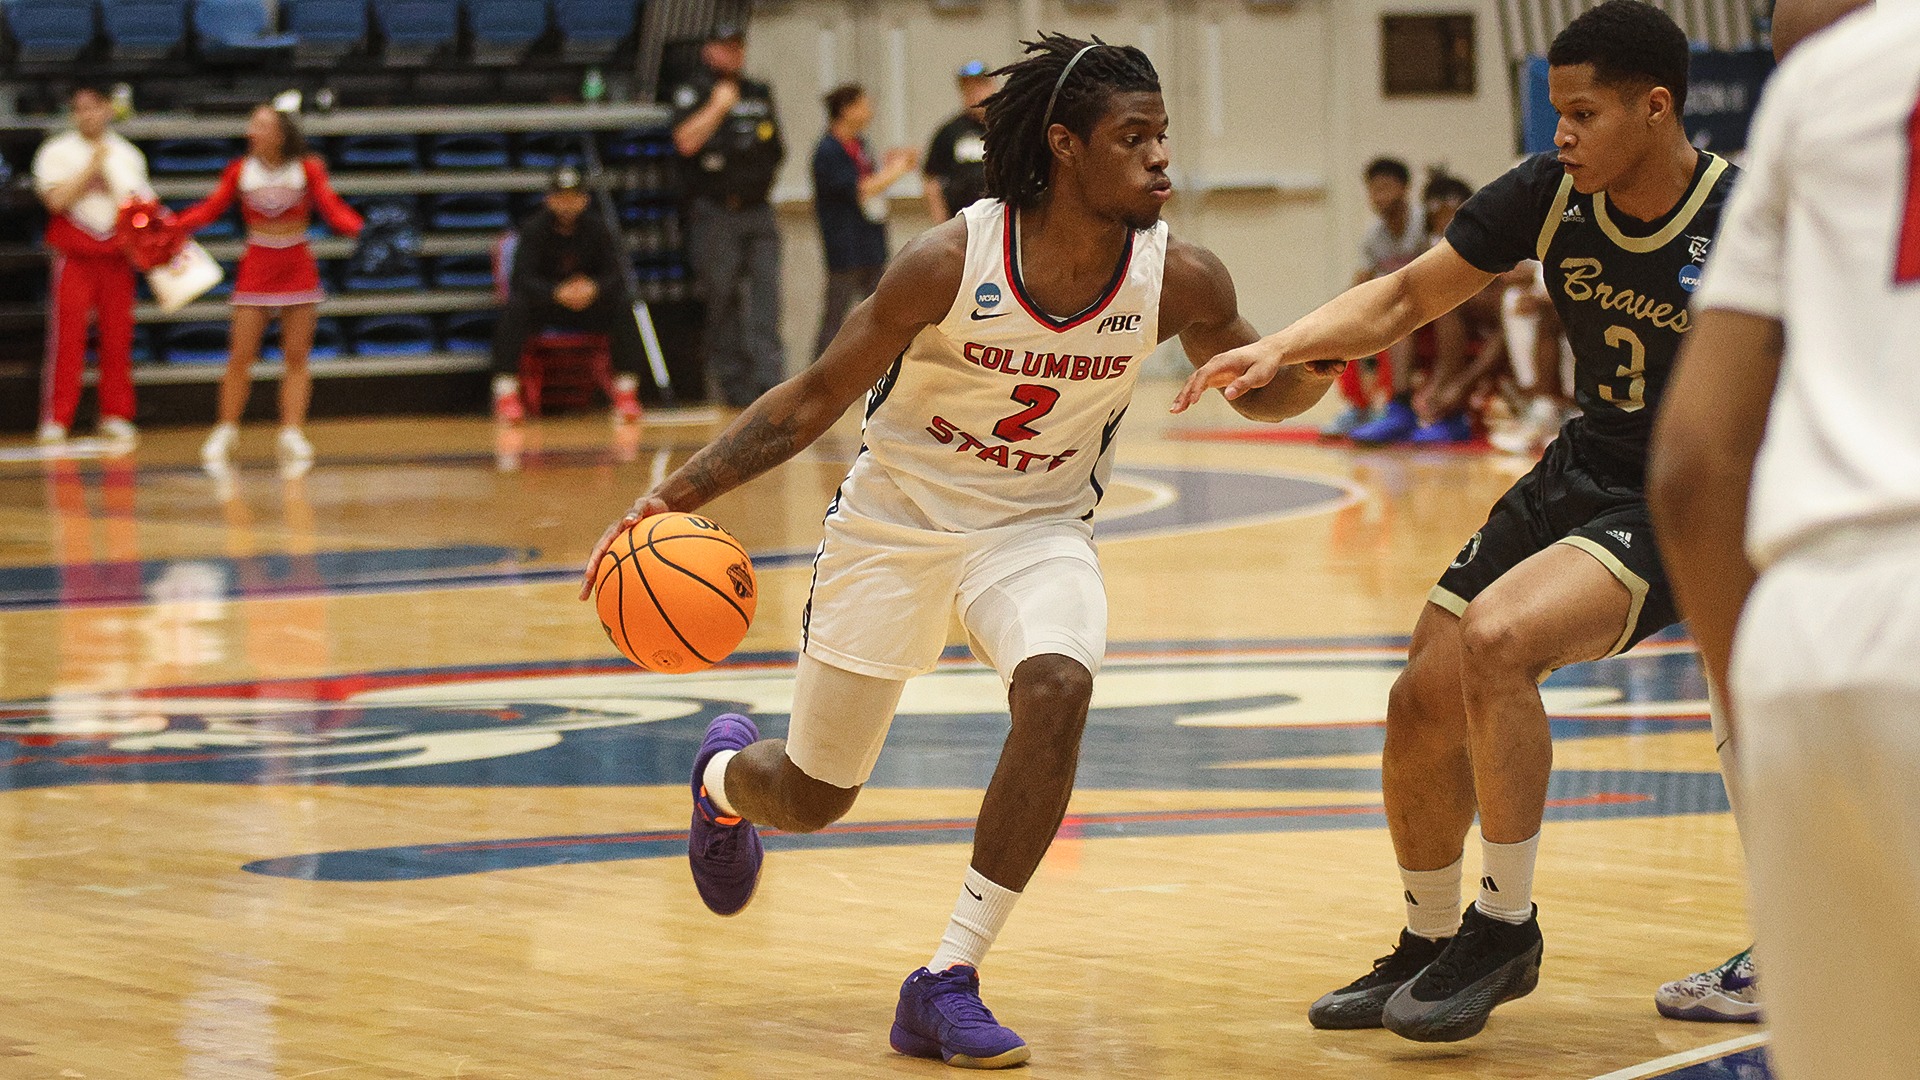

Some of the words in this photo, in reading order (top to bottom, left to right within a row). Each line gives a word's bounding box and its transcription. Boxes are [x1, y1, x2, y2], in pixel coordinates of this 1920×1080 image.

[979, 294, 1000, 302] NCAA
[1559, 257, 1692, 333] Braves
[1096, 314, 1142, 335] PBC
[964, 341, 1133, 381] COLUMBUS
[1598, 325, 1645, 413] 3
[992, 383, 1061, 443] 2
